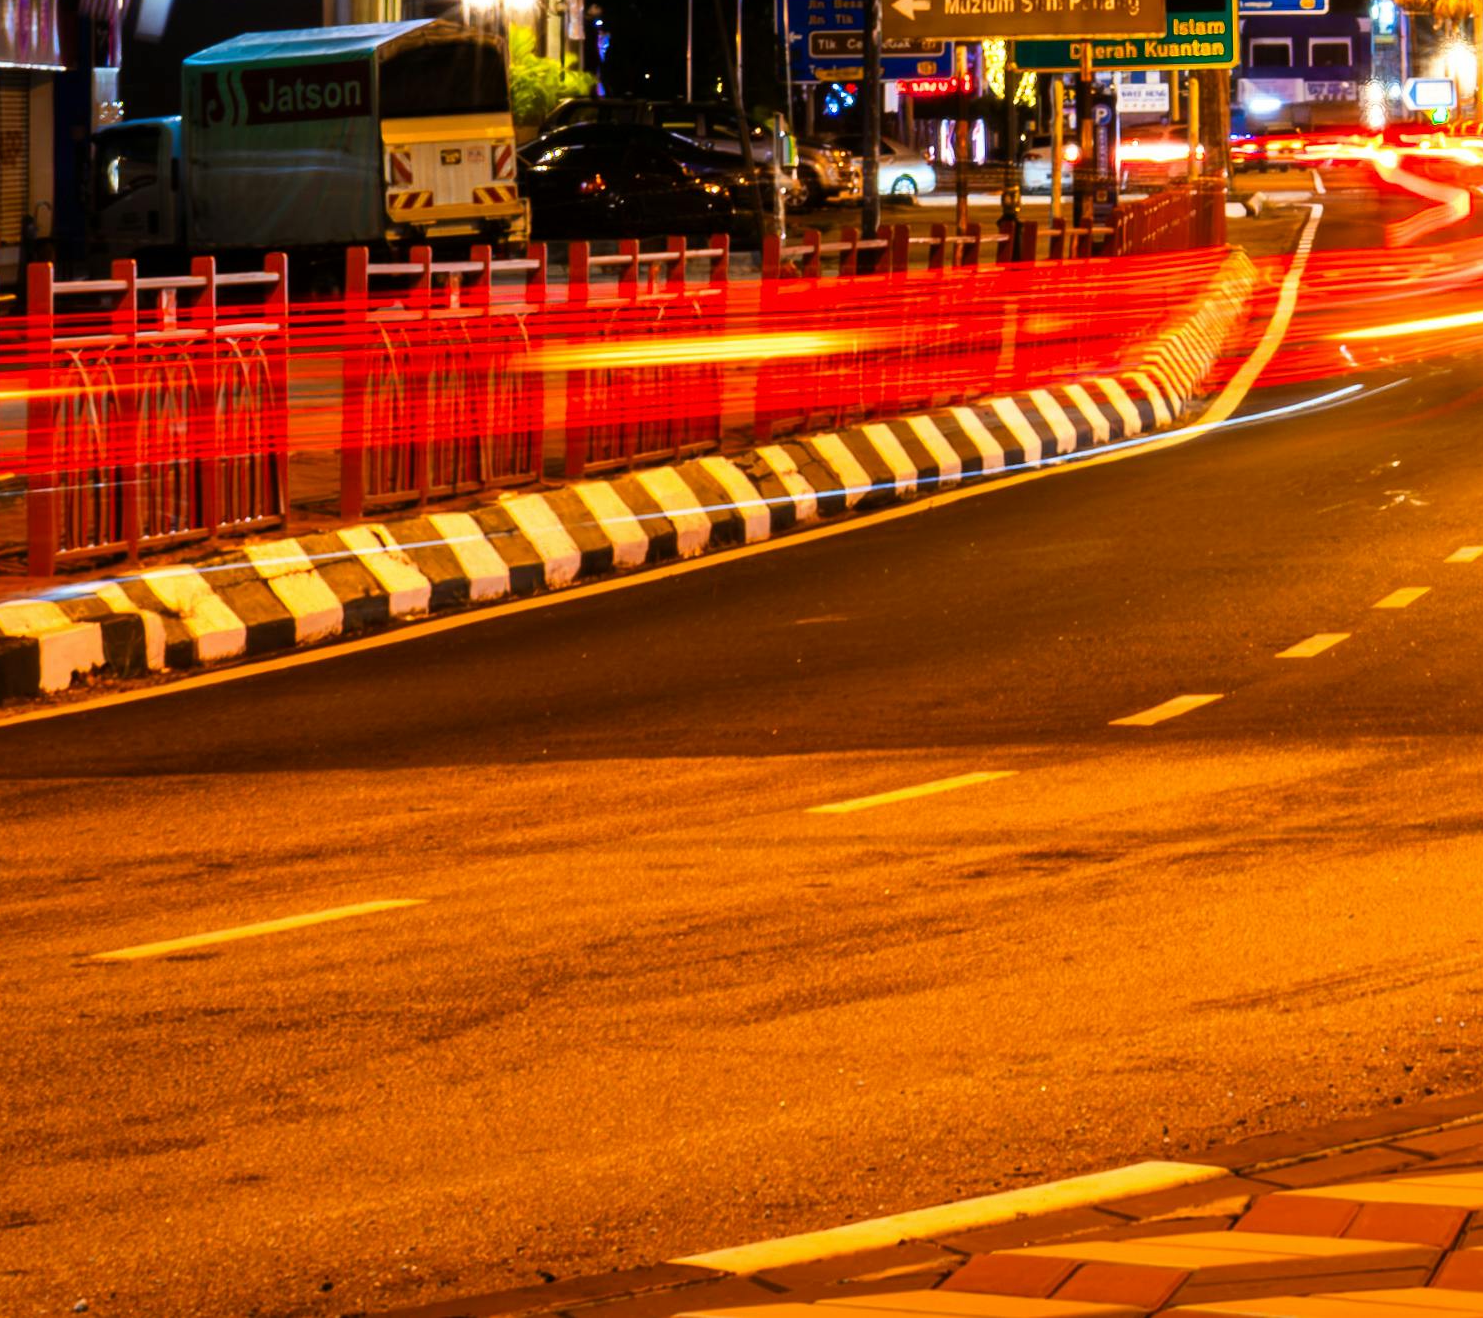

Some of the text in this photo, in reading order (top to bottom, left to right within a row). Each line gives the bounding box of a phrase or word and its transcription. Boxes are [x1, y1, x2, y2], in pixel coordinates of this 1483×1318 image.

[1173, 19, 1225, 35] Islam
[1144, 39, 1224, 57] Kuantan
[257, 79, 362, 112] Jatson
